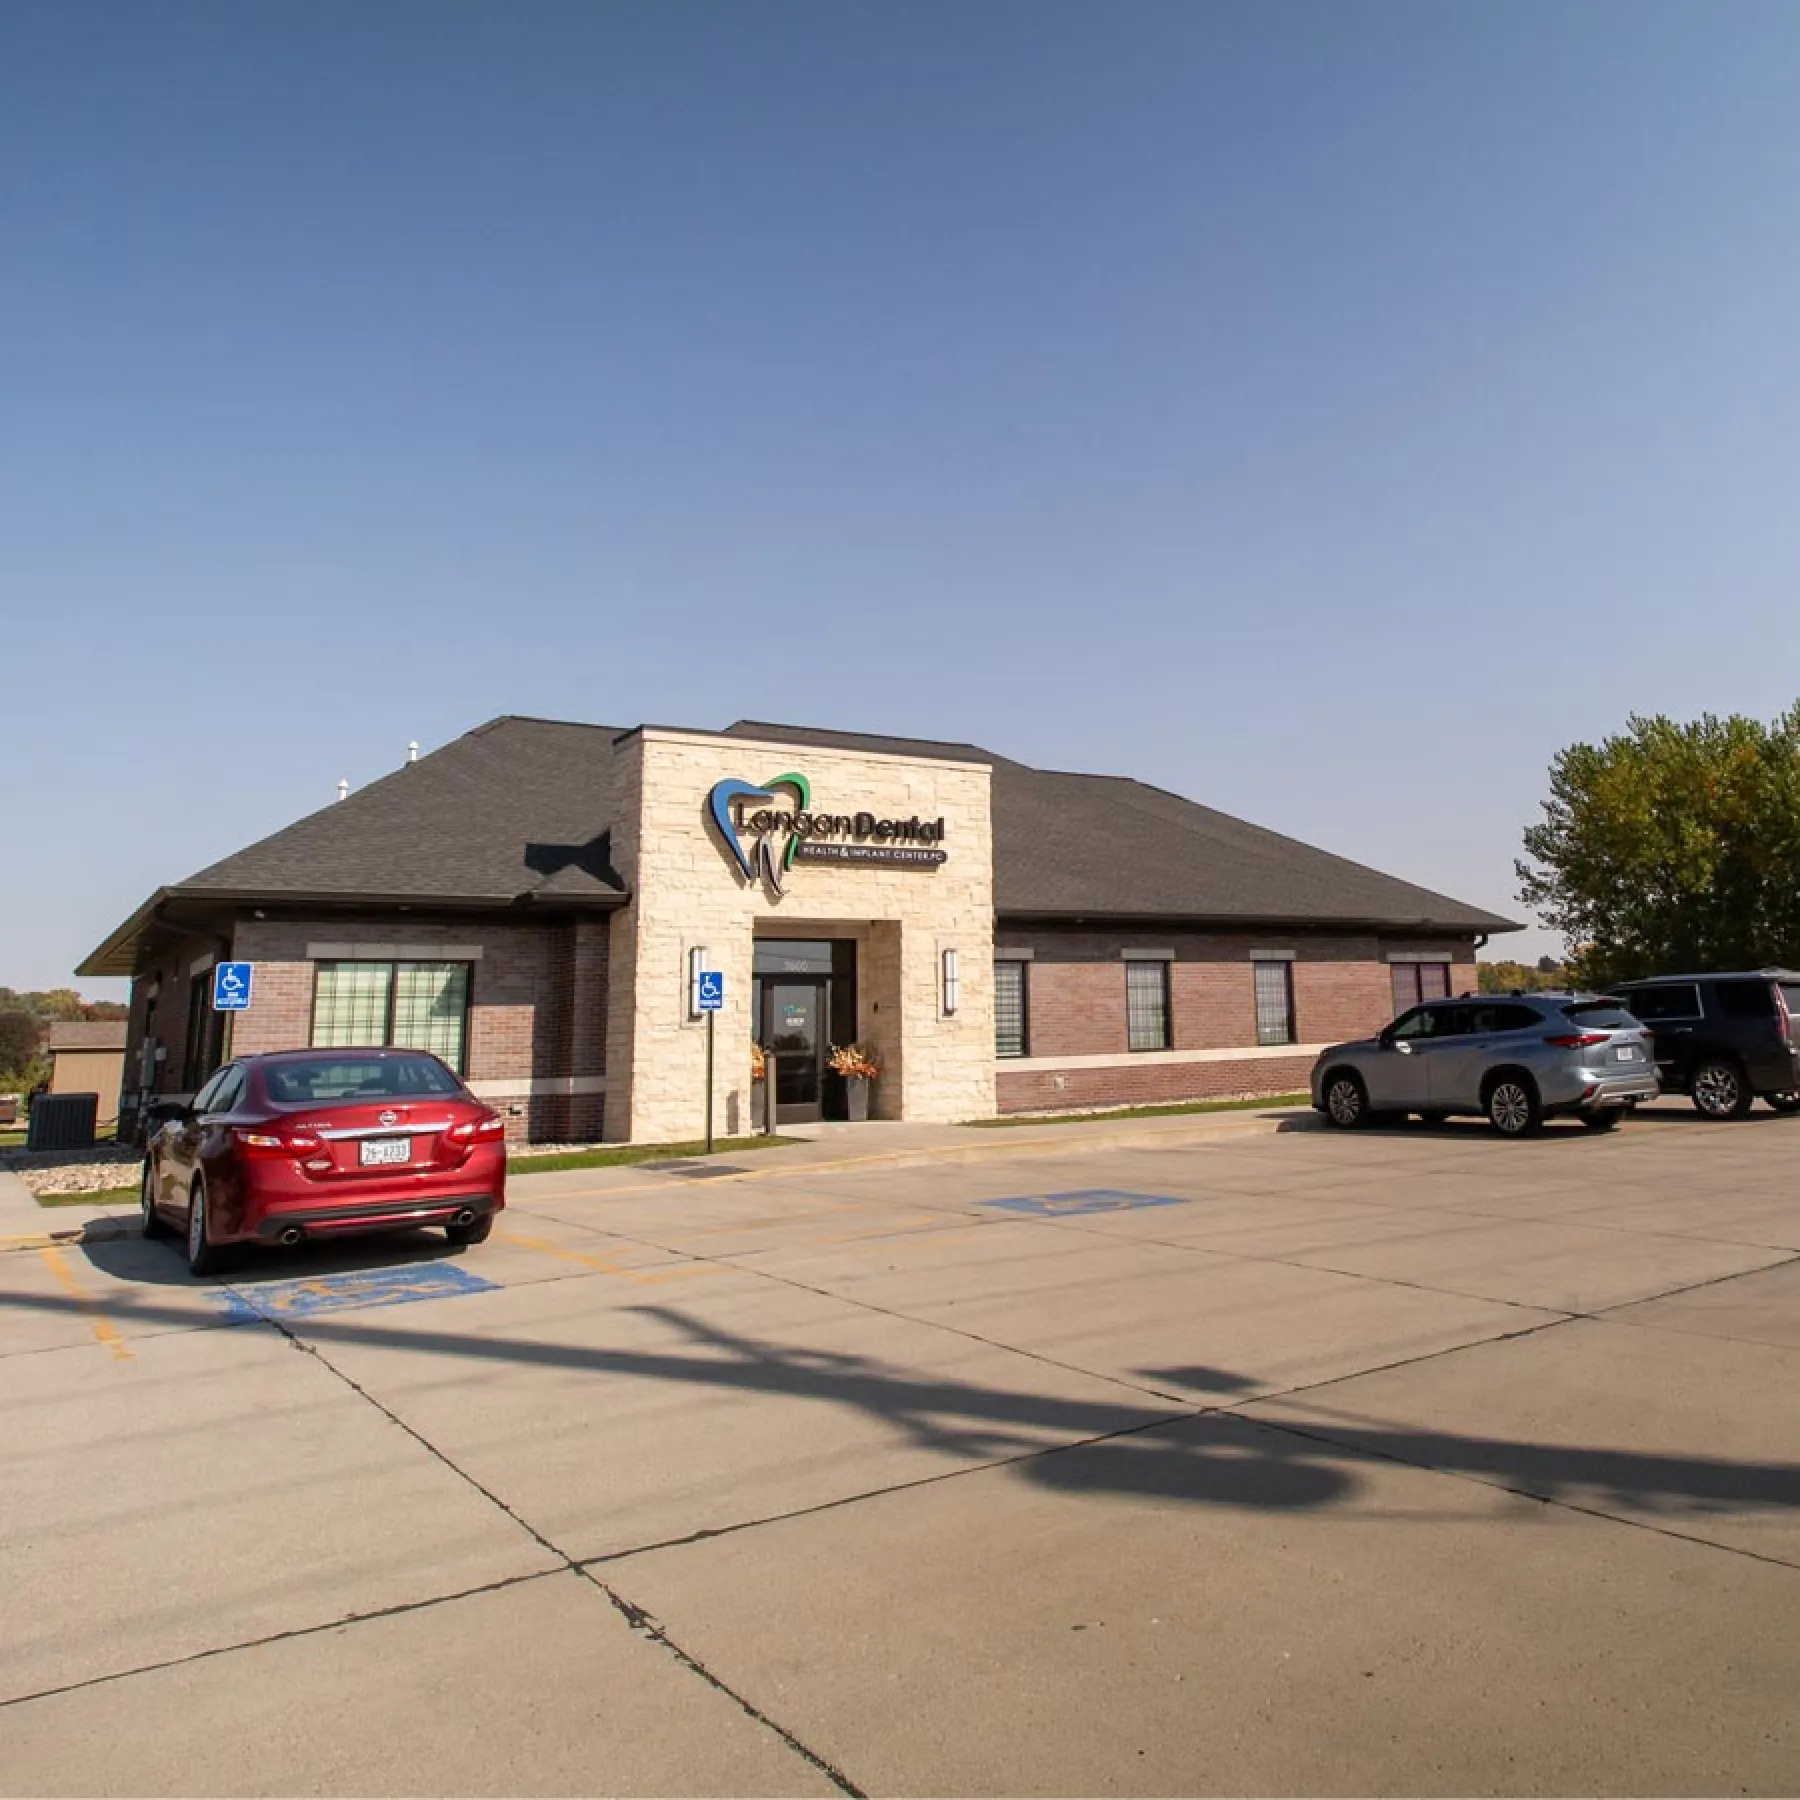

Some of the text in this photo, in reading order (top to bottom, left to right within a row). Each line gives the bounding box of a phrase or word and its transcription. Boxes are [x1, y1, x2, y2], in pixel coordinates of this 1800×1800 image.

[737, 802, 945, 841] Langan Dental
[803, 846, 839, 856] HEALTH
[840, 845, 849, 858] &
[849, 848, 890, 859] IMPLANT
